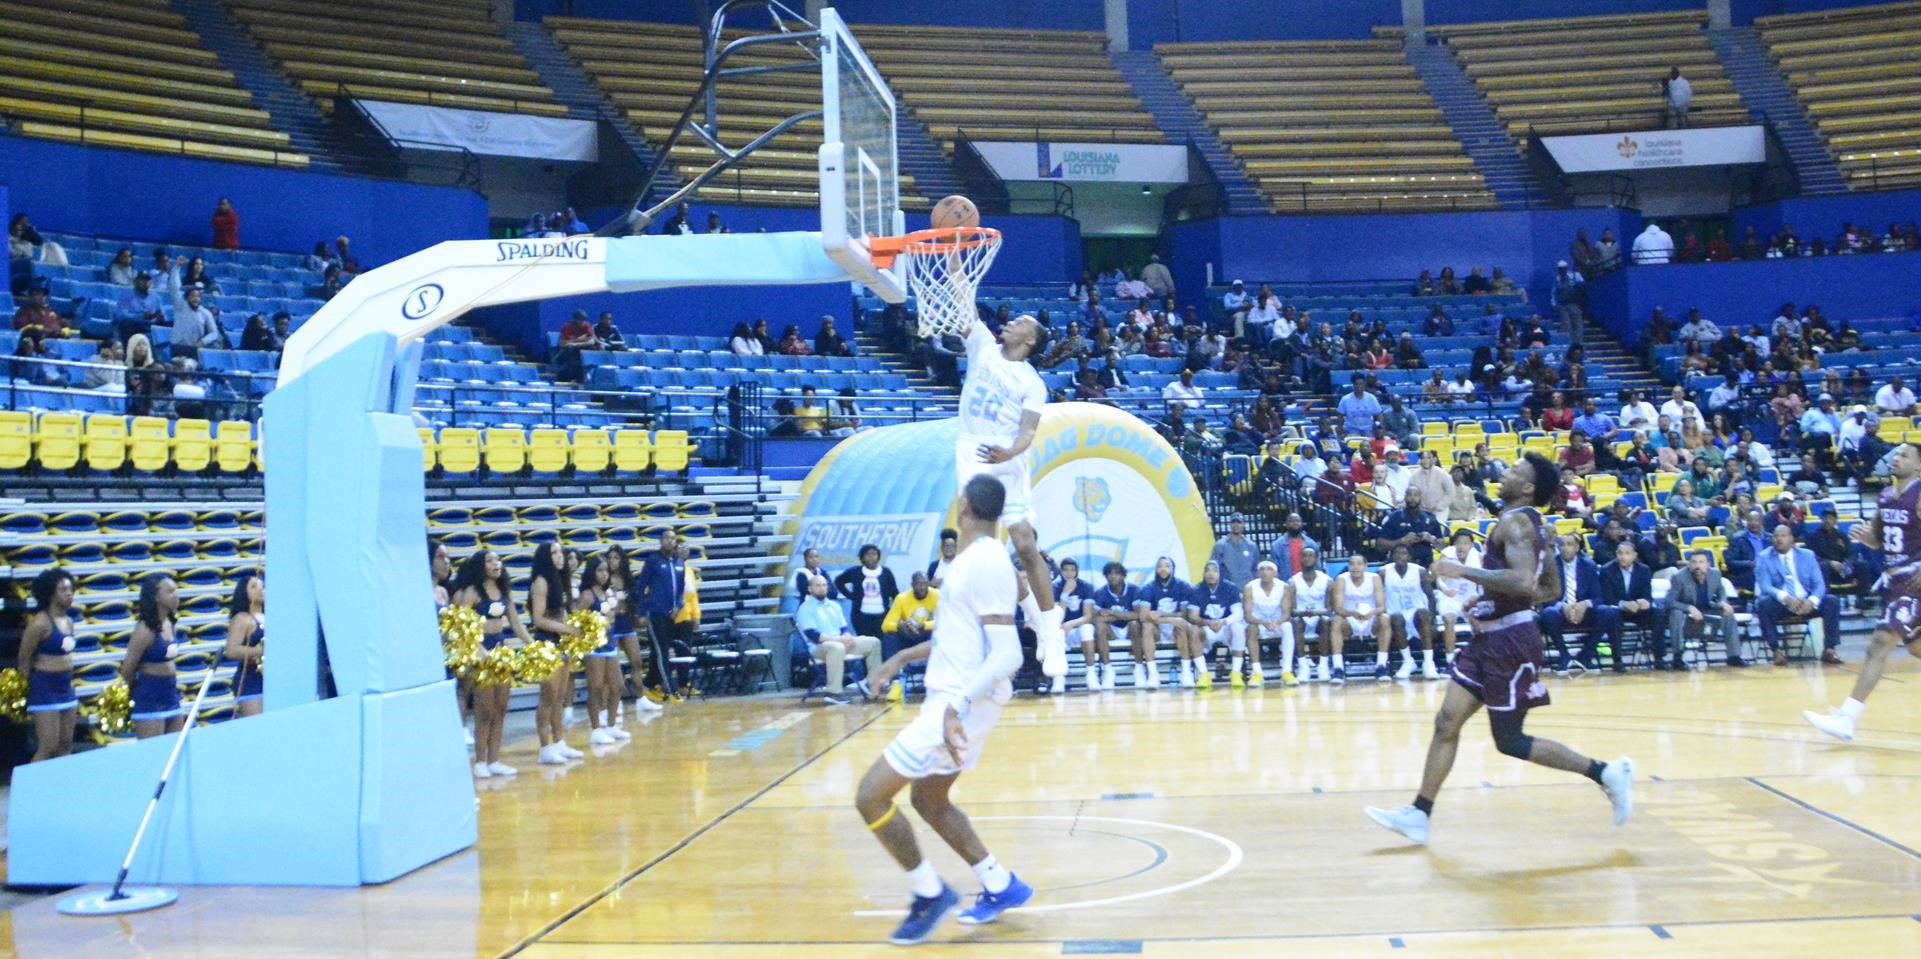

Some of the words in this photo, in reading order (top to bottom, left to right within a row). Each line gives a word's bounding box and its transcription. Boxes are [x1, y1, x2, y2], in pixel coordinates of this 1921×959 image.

[1063, 151, 1121, 164] LOUISIANA
[1068, 163, 1118, 175] LOTTERY
[496, 239, 588, 262] SPALDING
[1030, 425, 1078, 476] JAG
[1084, 423, 1172, 470] DOME
[800, 519, 923, 553] SOUTHERN
